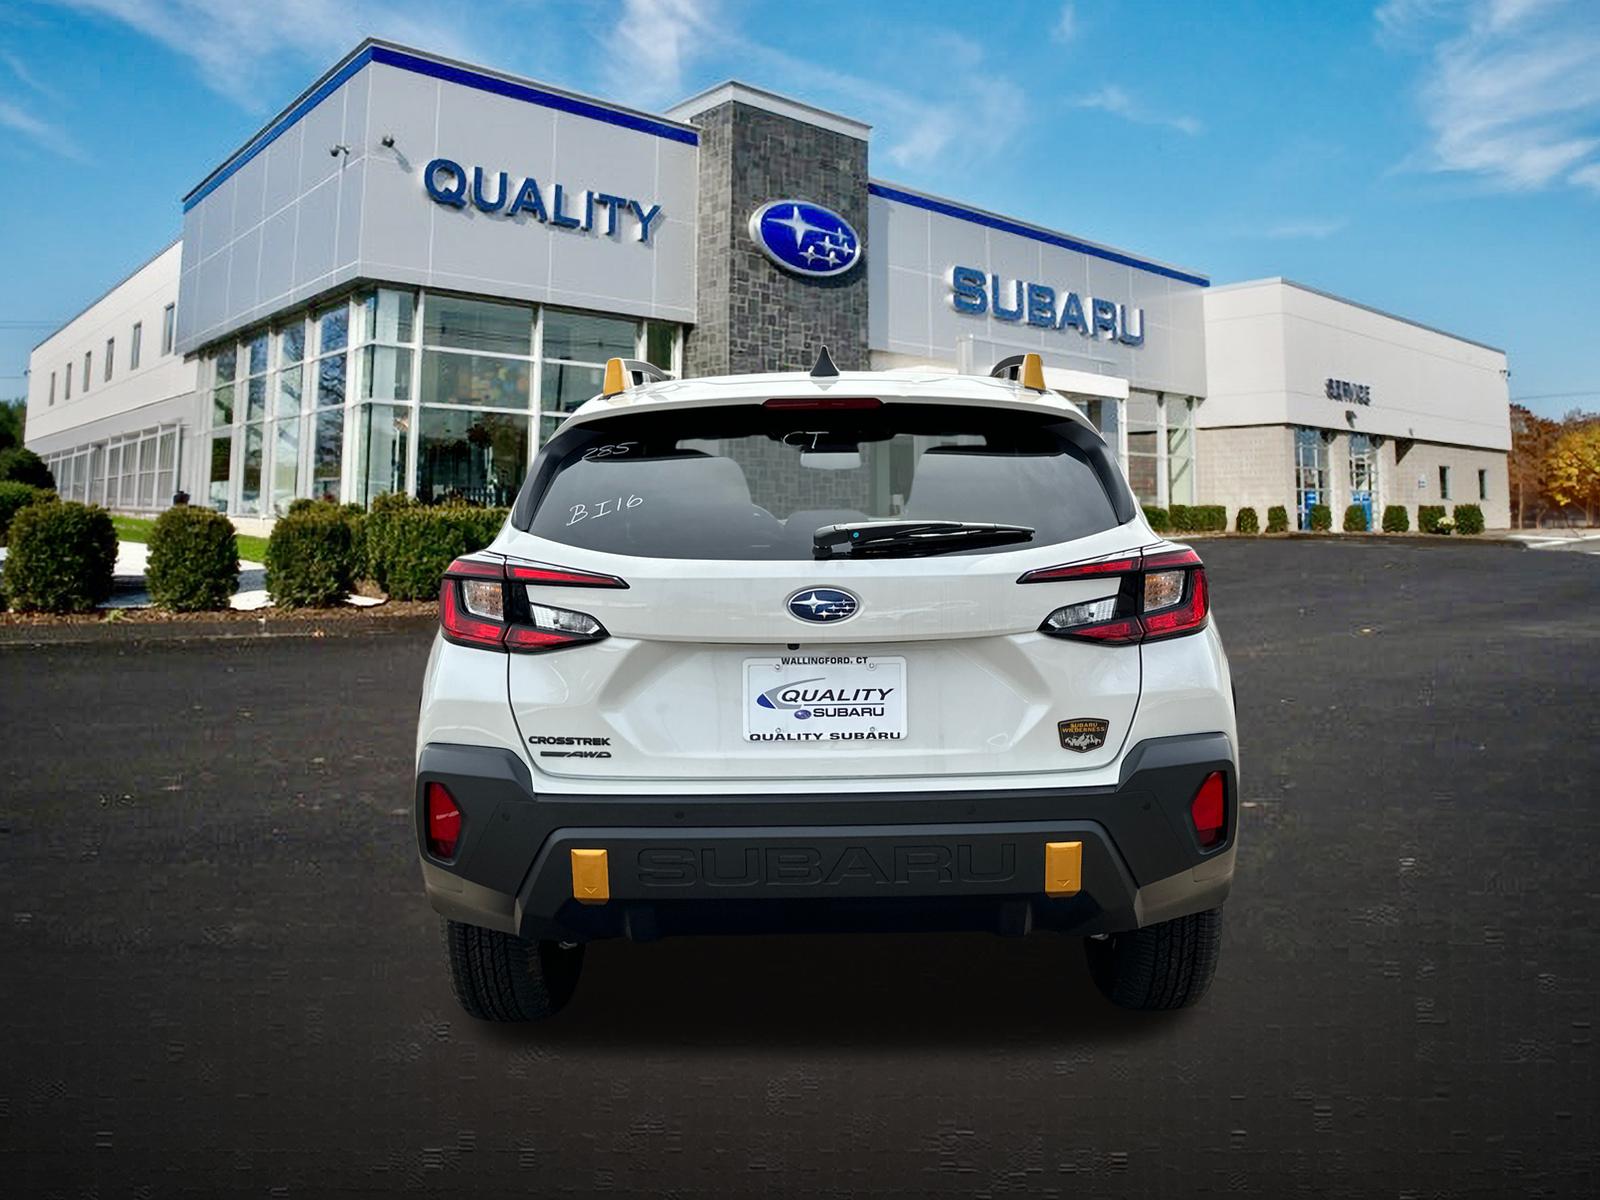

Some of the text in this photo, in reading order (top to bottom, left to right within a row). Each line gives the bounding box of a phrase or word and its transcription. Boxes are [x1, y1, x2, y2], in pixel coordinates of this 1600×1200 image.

[424, 158, 662, 242] QUALITY
[949, 265, 1145, 347] SUBARU
[782, 431, 829, 449] CT
[582, 442, 639, 460] 285
[857, 656, 868, 664] CT
[781, 688, 895, 703] QUALITY
[813, 707, 885, 717] SUBARU
[528, 736, 611, 746] CROSSTREK
[750, 732, 901, 741] QUALITY SUBARU
[637, 843, 1017, 889] SUBARU
